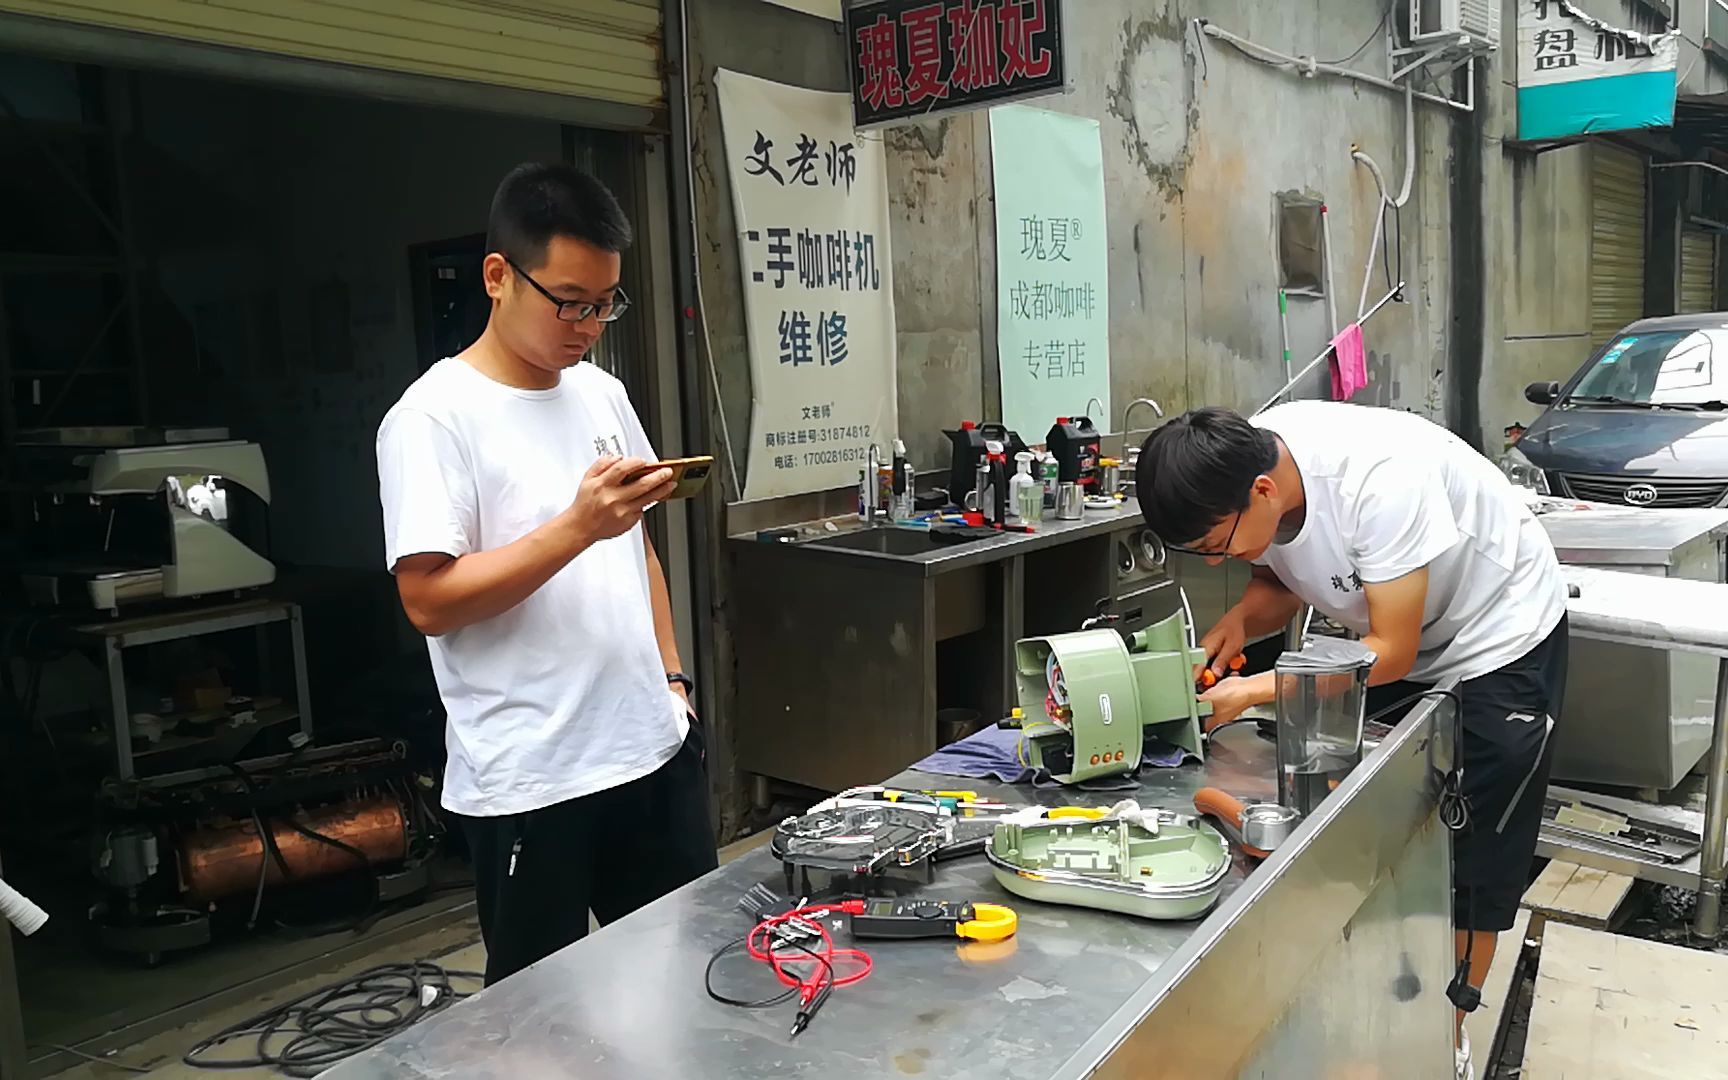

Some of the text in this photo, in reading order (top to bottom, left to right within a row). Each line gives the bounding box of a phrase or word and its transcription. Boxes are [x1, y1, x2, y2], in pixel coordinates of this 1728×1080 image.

[744, 129, 855, 196] 文老师
[1010, 280, 1095, 321] 成都咖啡
[778, 310, 849, 367] 维修
[1022, 339, 1086, 380] 专营店
[1628, 490, 1653, 499] BYD
